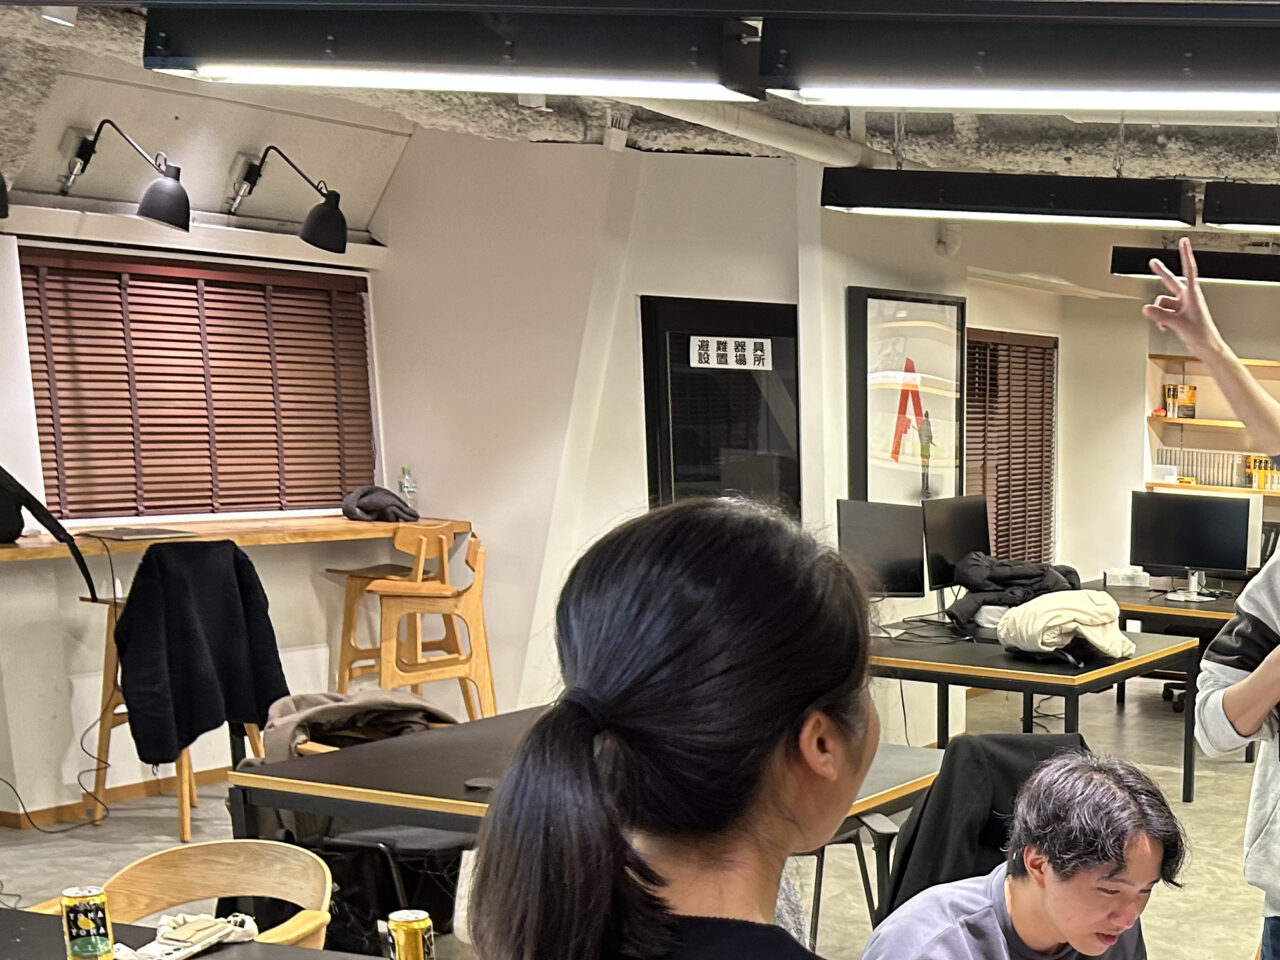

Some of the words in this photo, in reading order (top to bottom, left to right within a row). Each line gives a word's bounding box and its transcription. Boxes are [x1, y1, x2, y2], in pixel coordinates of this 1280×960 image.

[698, 339, 765, 354] 避難器具
[697, 352, 766, 367] 設置場所
[71, 926, 106, 936] YONA
